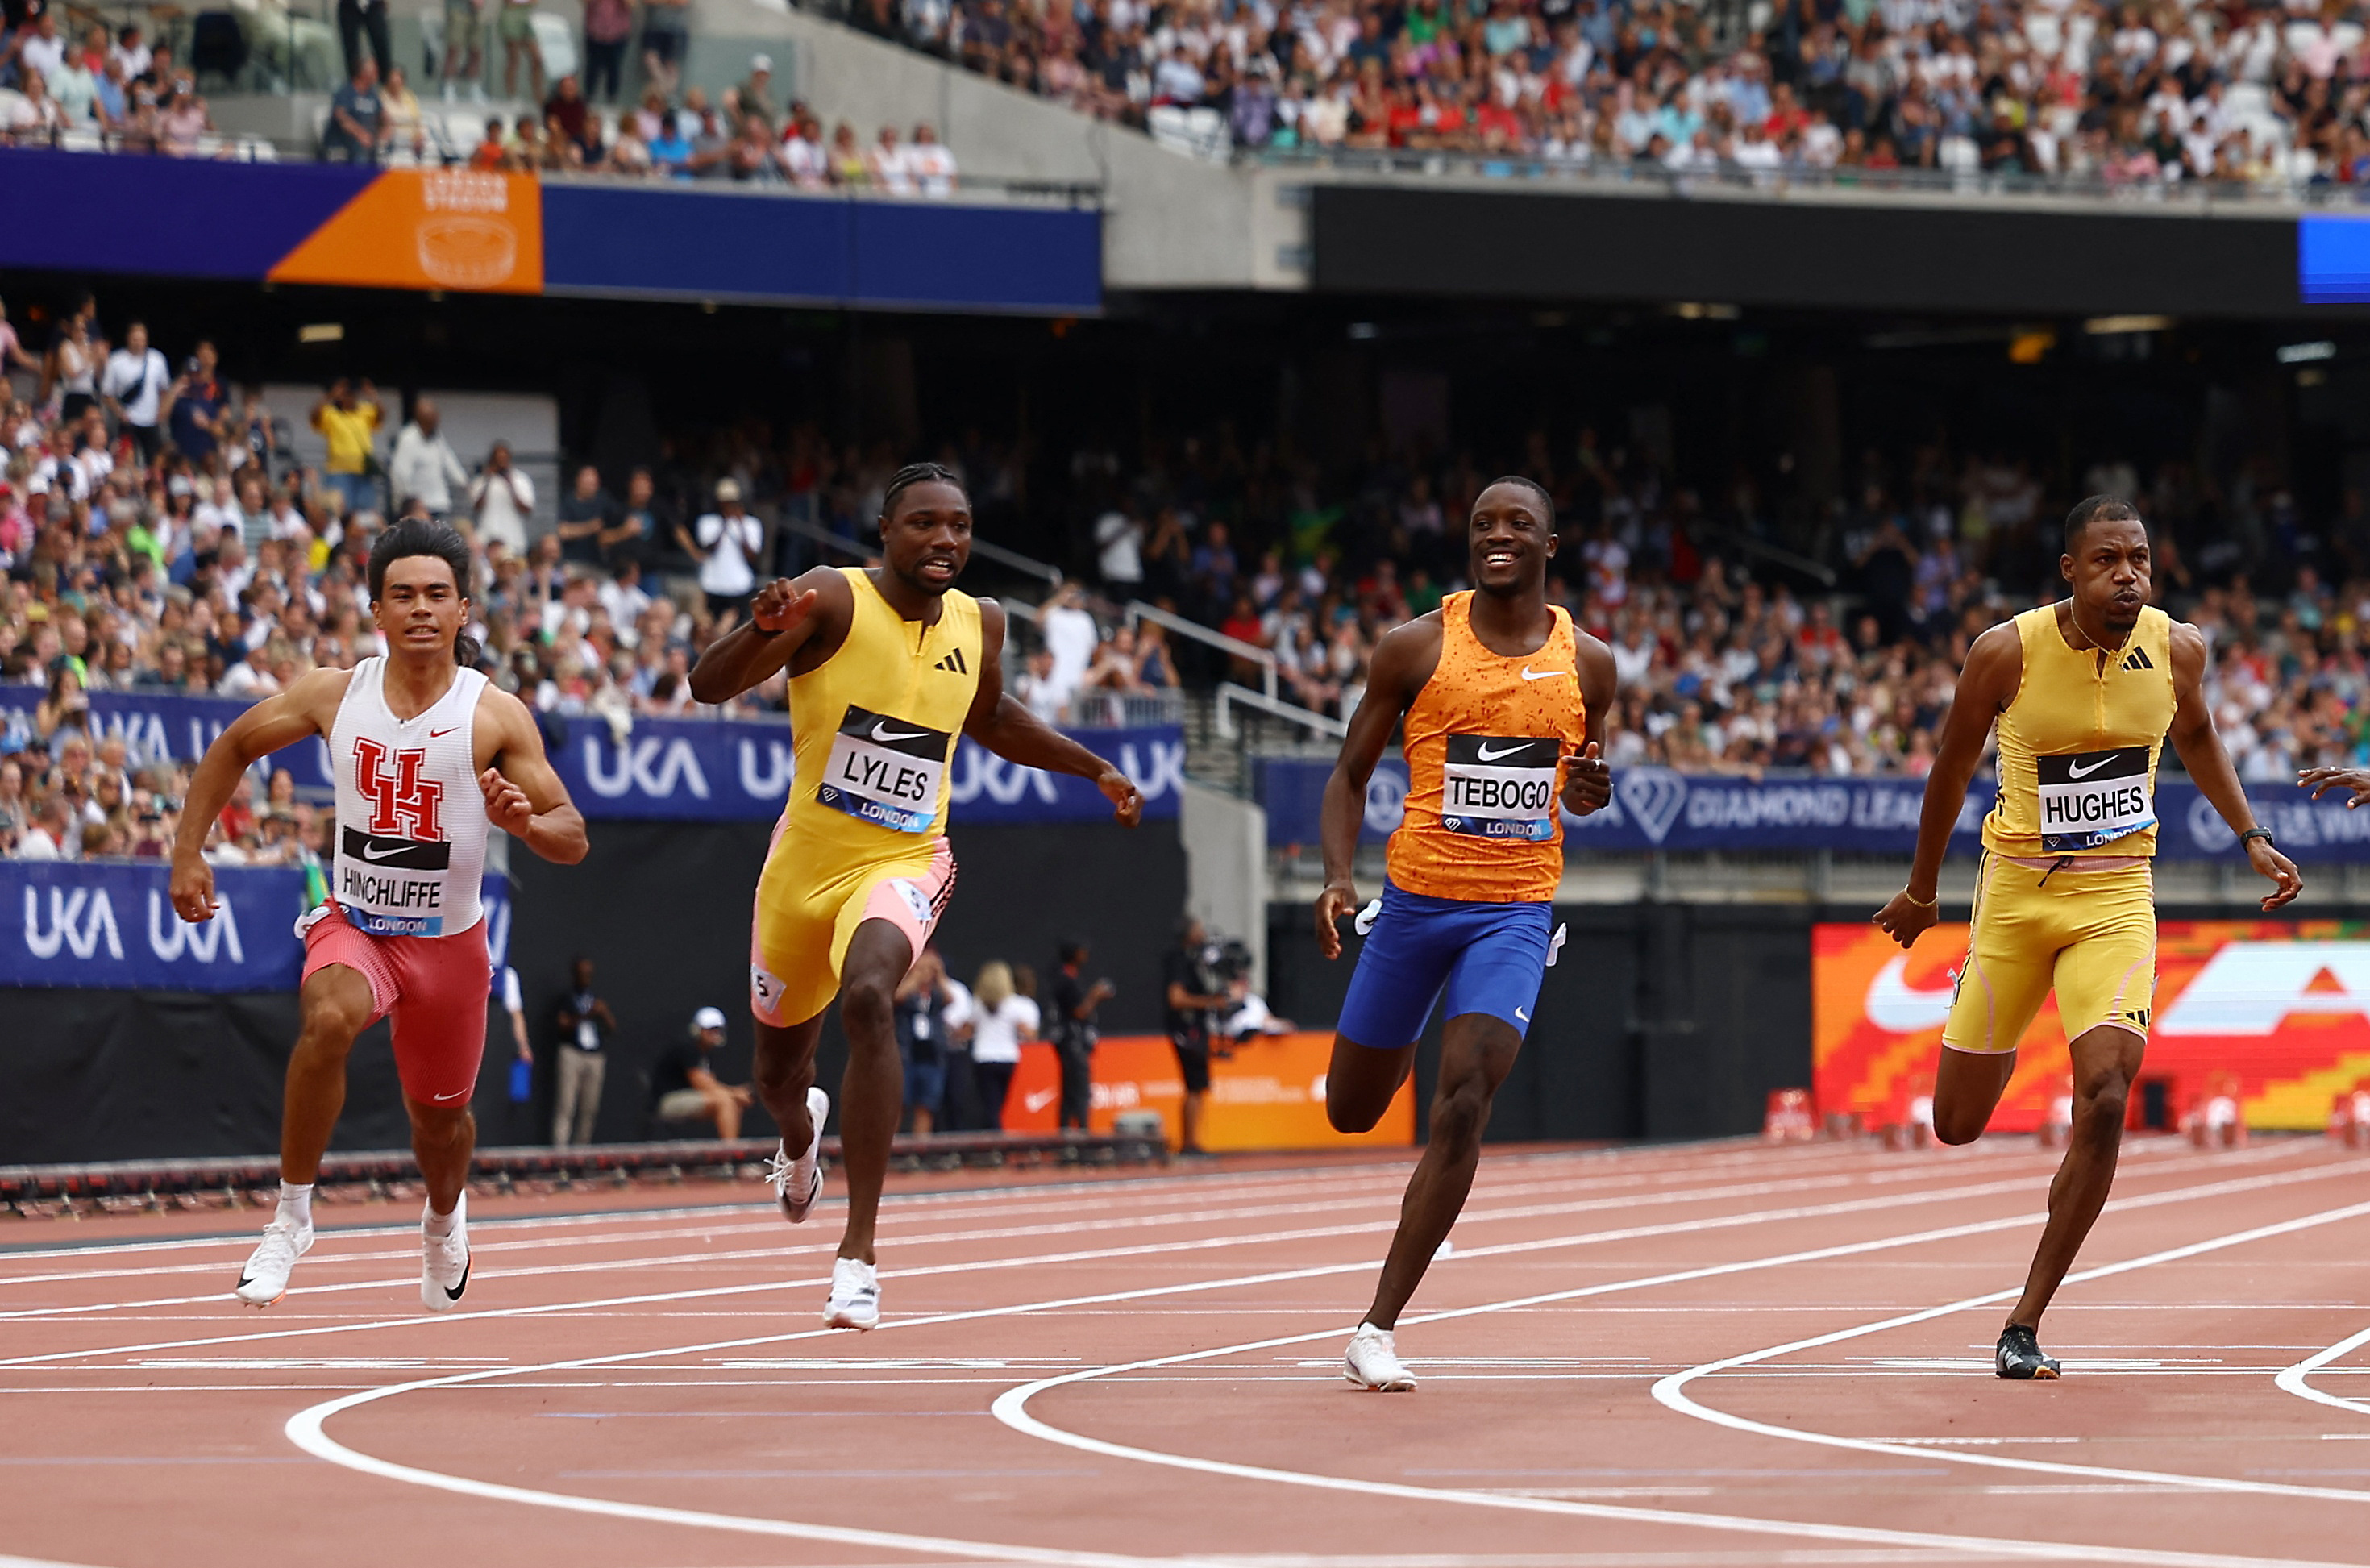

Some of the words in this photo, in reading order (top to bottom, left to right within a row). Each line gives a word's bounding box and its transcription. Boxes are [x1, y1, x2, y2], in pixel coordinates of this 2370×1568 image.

[584, 734, 711, 800] UKA
[843, 751, 928, 801] LYLES
[1449, 776, 1549, 809] TEBOGO
[1686, 785, 1850, 828] DIAMOND
[2046, 786, 2144, 824] HUGHES
[860, 802, 919, 828] LONDON
[1486, 822, 1542, 835] LONDON
[2086, 826, 2142, 846] LONDO
[343, 867, 442, 908] HINCHLIFFE
[25, 884, 124, 961] UKA
[369, 917, 427, 932] LONDON
[757, 975, 769, 997] 5
